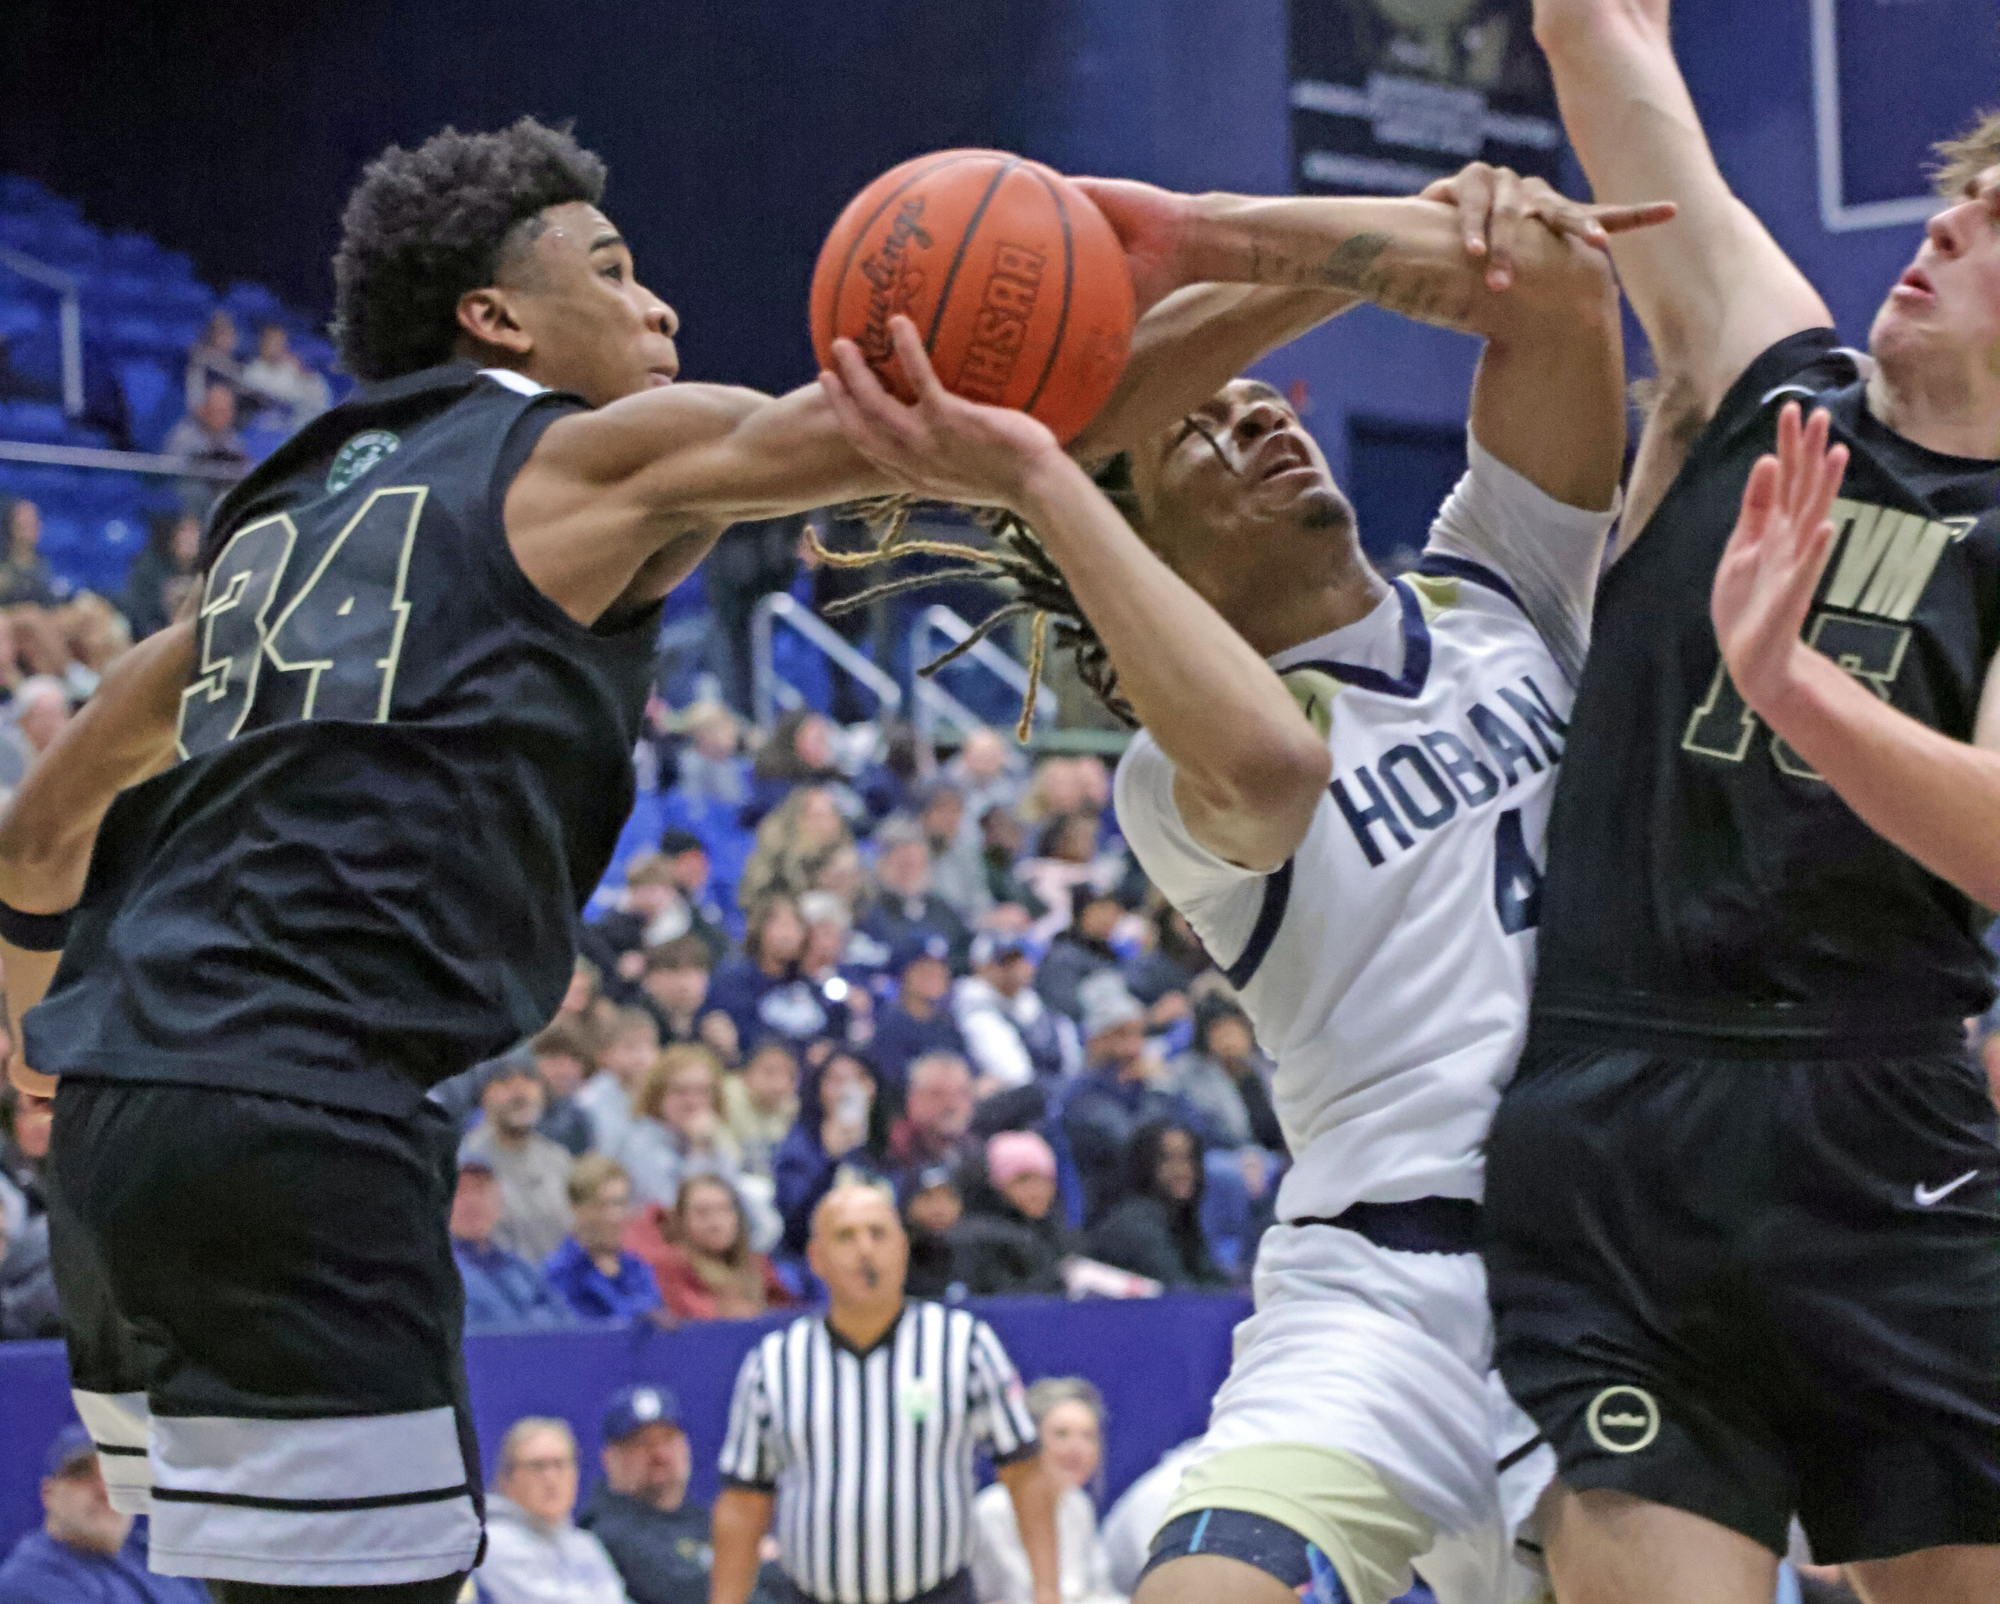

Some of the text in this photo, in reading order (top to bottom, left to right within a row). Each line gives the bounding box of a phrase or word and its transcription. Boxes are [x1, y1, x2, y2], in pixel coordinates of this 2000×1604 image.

[176, 485, 430, 761] 34
[1329, 675, 1569, 868] HOBAN
[1495, 808, 1543, 936] 4
